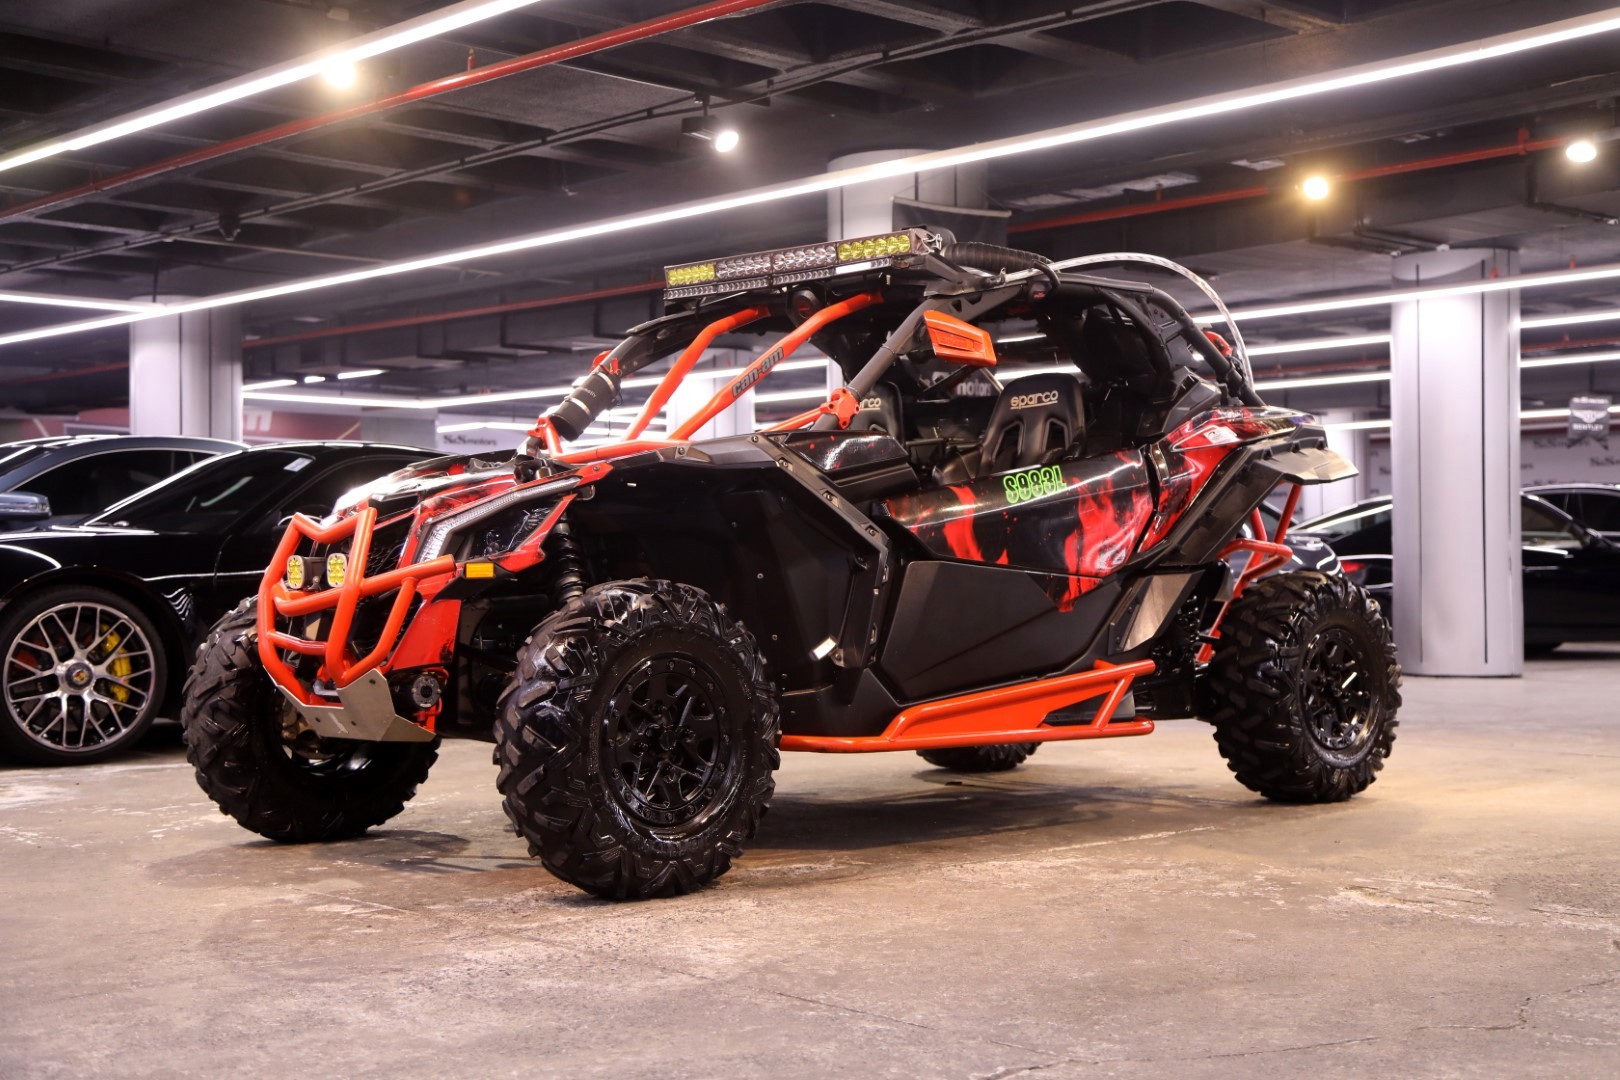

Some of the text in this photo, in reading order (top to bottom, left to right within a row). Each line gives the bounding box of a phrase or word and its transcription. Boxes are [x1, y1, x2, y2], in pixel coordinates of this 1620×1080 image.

[732, 346, 784, 398] can-am
[1010, 390, 1059, 410] sparco
[1003, 464, 1067, 504] S983L
